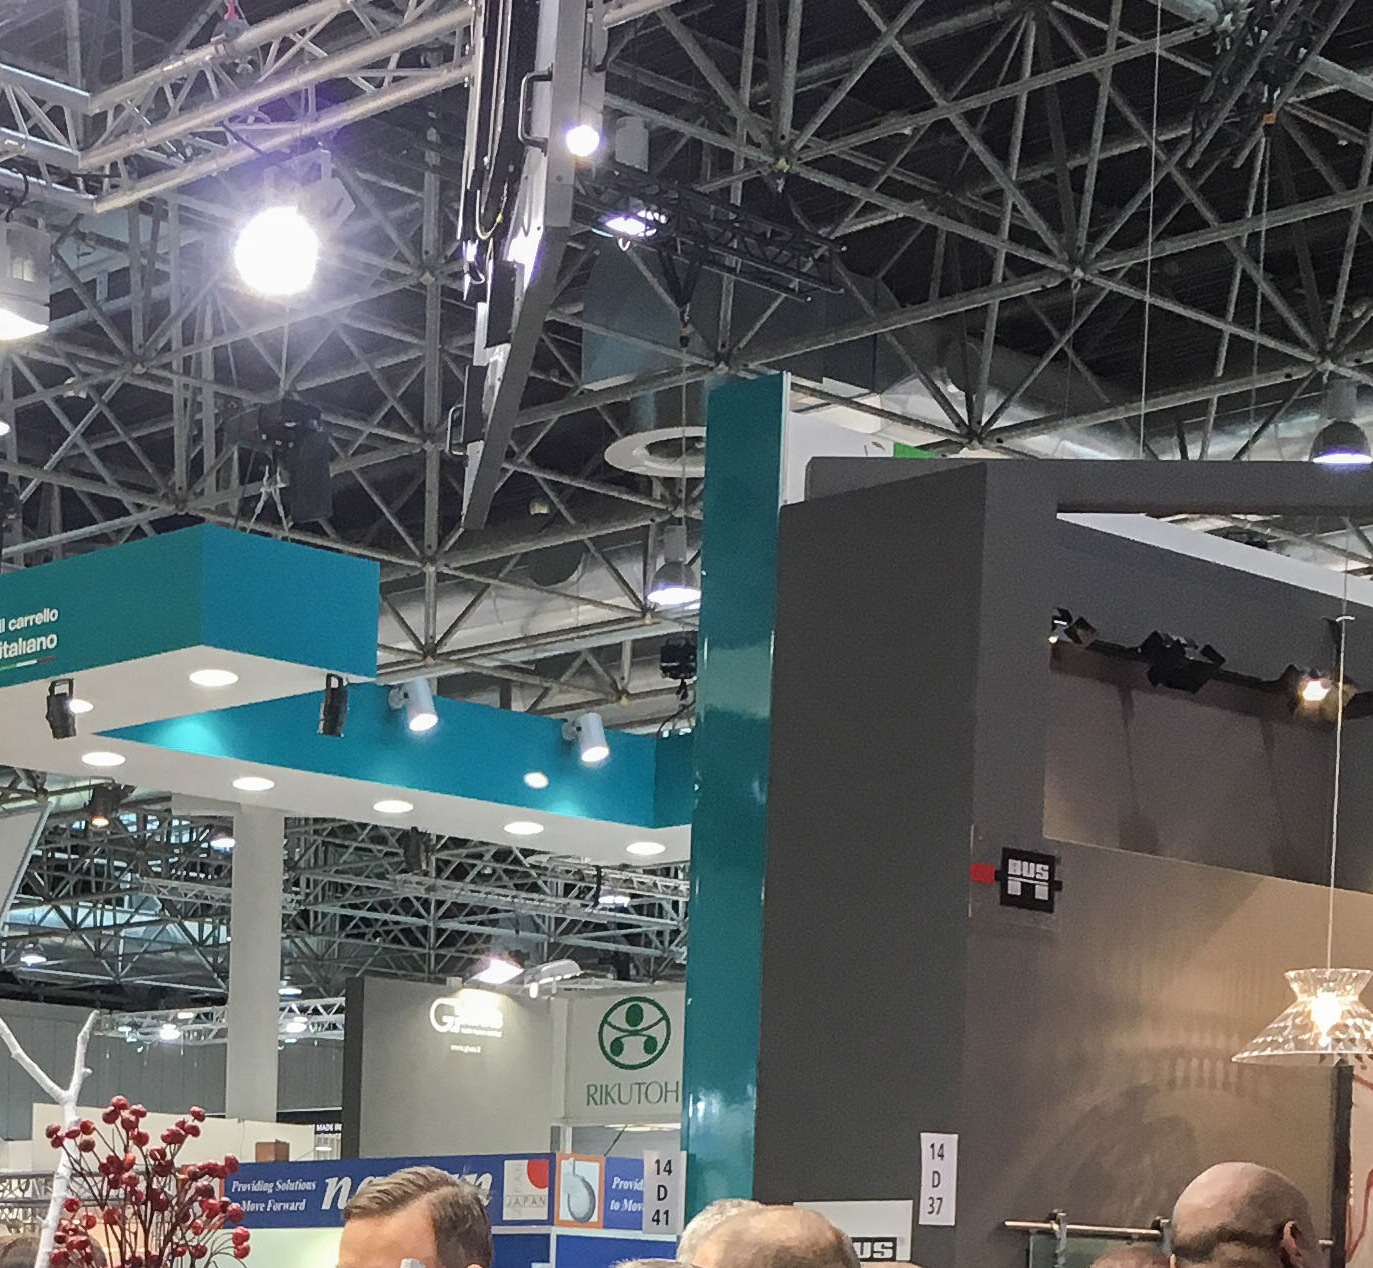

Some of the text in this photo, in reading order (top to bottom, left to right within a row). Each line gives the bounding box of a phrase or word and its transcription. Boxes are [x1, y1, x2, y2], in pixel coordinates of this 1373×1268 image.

[8, 607, 59, 632] carrello
[1008, 858, 1049, 880] BUS
[586, 1080, 679, 1106] RIKUTOH
[929, 1142, 945, 1161] 14
[654, 1158, 673, 1176] 14
[231, 1178, 317, 1194] Providing Solutions
[611, 1176, 644, 1191] Provid
[931, 1171, 941, 1188] D
[657, 1184, 668, 1202] D
[266, 1198, 307, 1212] Forward
[610, 1198, 644, 1212] to Mov
[927, 1196, 943, 1216] 37
[651, 1208, 670, 1226] 41
[853, 1241, 894, 1259] US
